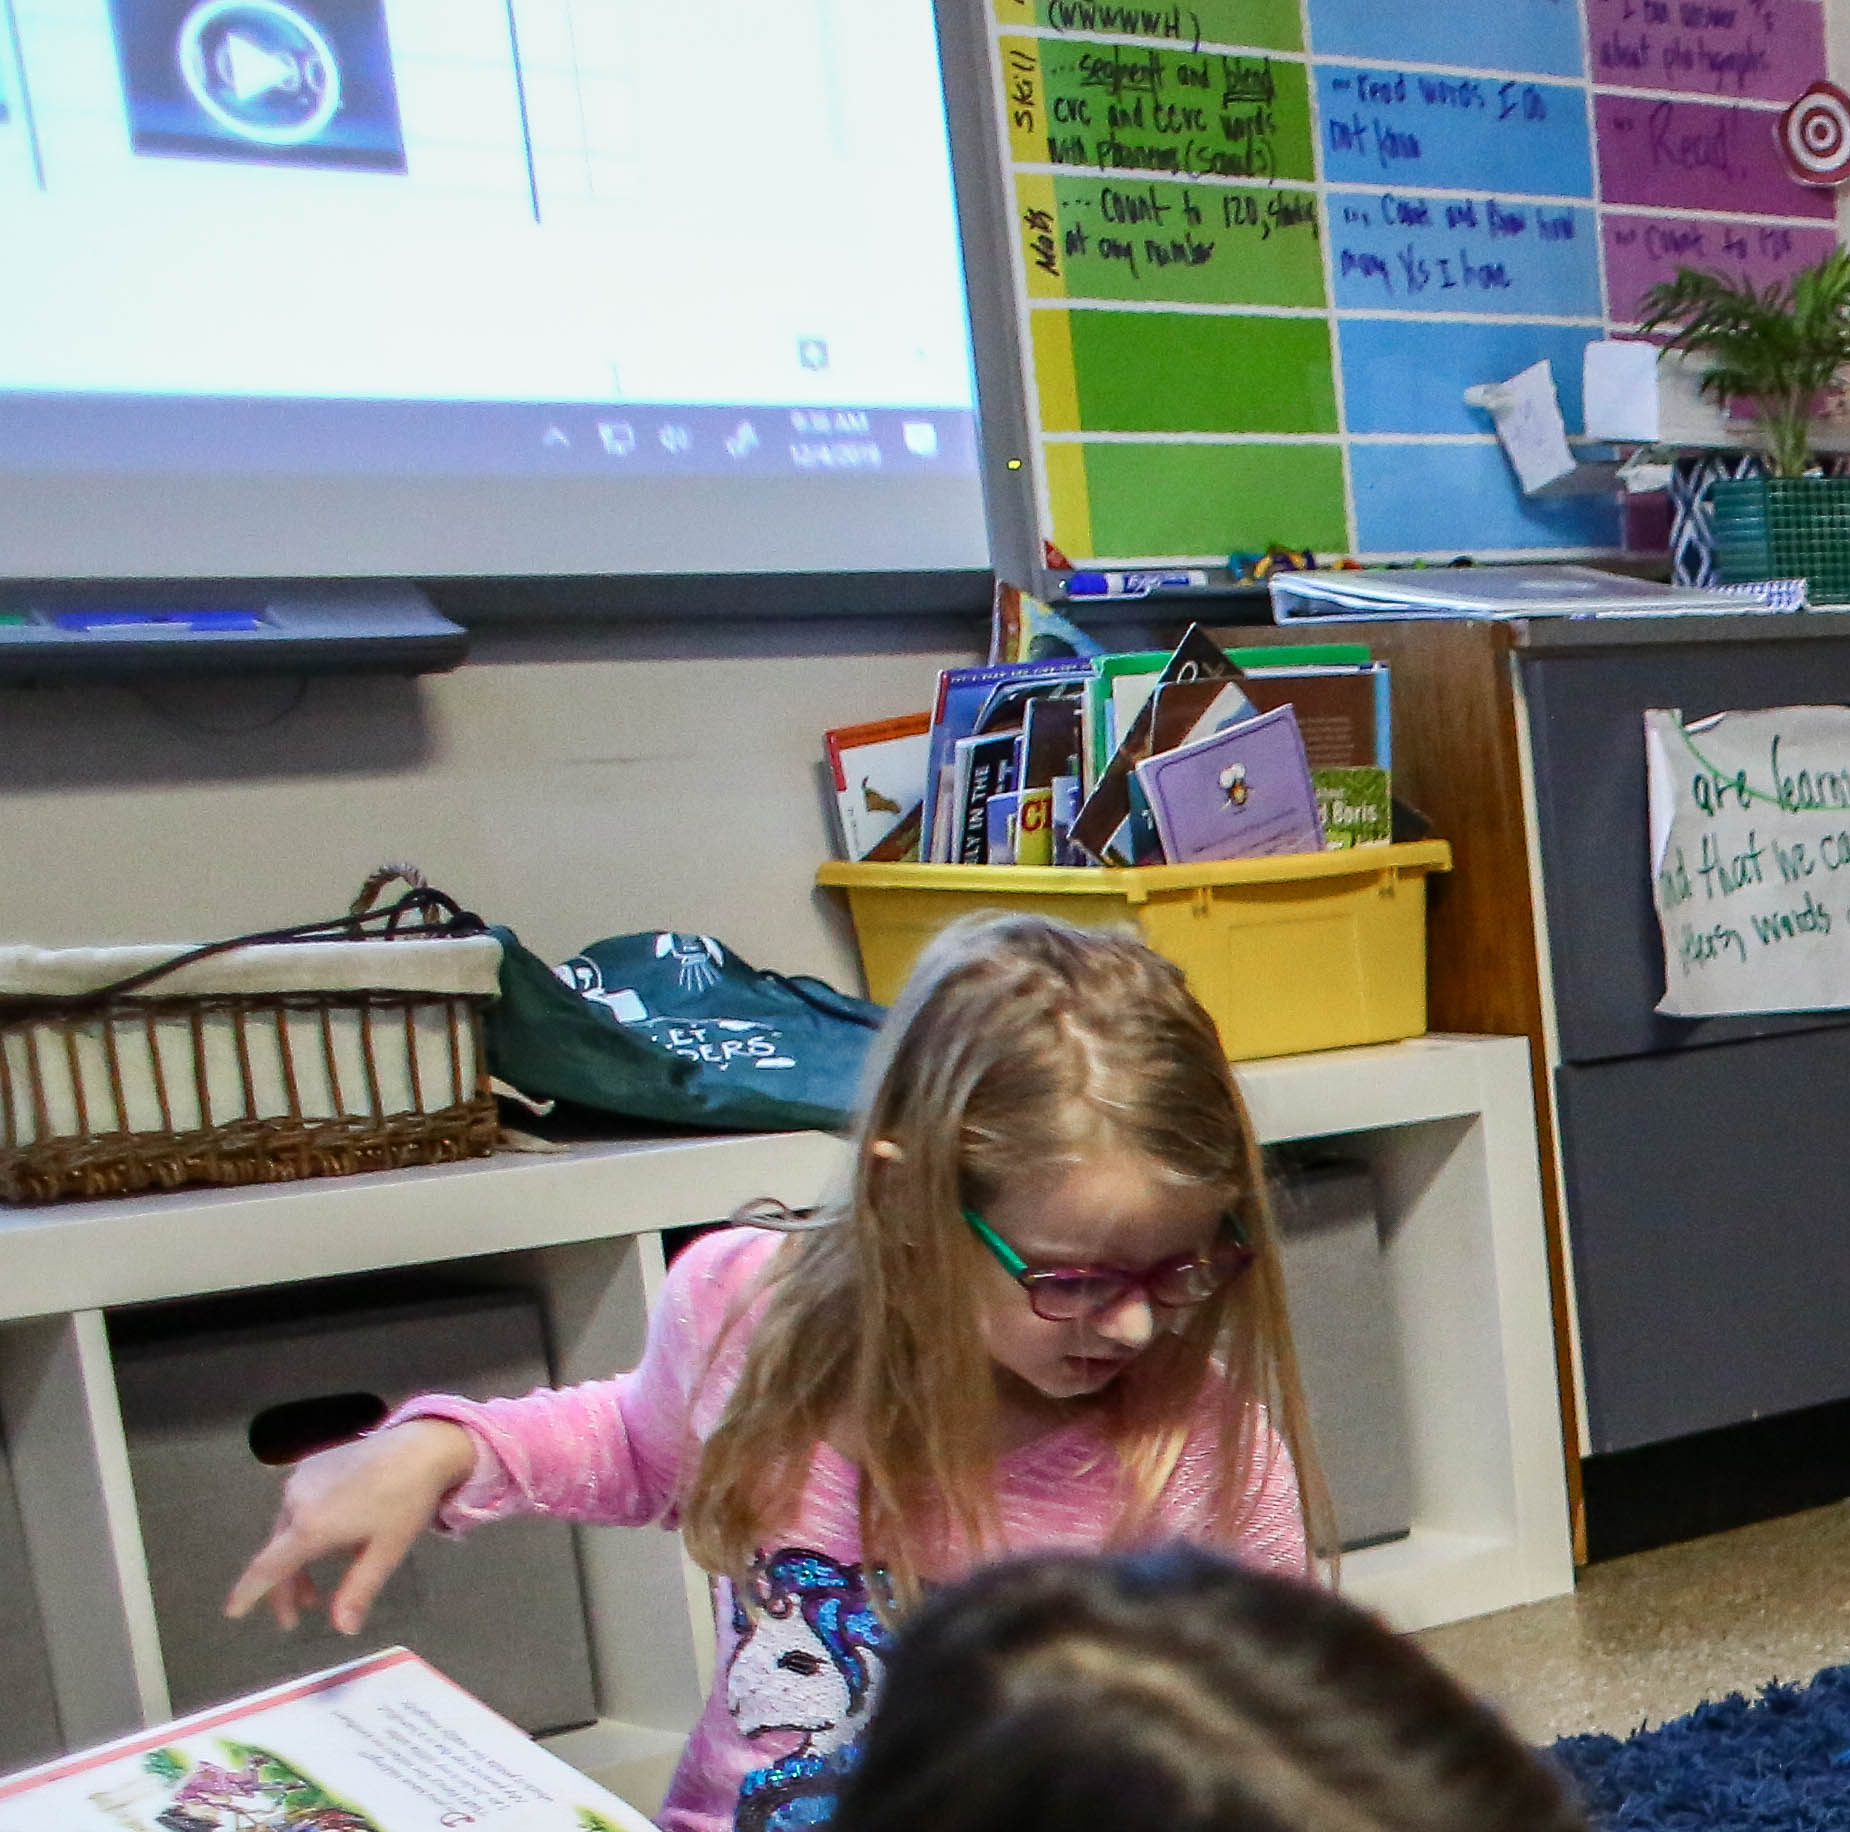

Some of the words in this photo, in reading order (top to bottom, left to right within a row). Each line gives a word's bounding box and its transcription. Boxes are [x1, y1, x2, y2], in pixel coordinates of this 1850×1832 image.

[971, 763, 991, 804] THE
[1693, 769, 1752, 818] are
[1332, 798, 1379, 823] Boris
[1697, 830, 1765, 899] that
